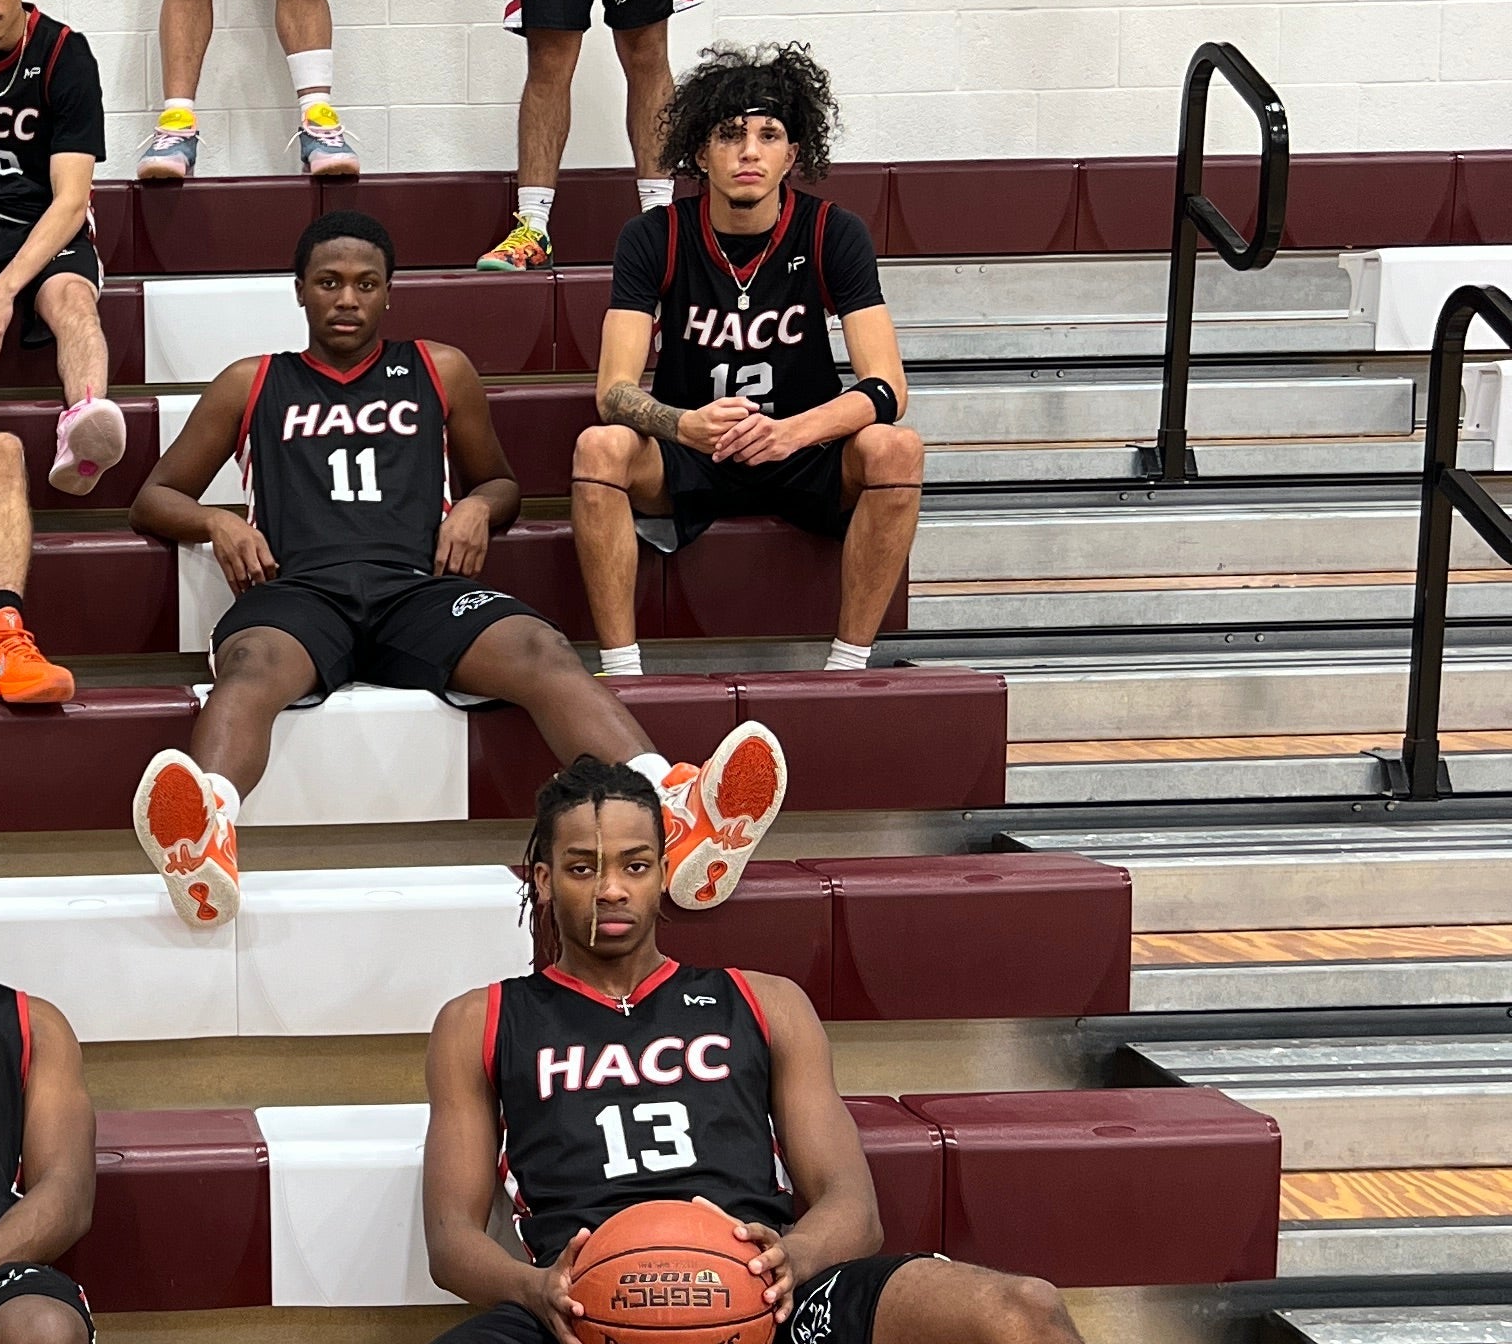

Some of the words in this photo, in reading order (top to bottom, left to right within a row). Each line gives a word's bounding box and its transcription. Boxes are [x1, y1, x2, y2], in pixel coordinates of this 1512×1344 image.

[683, 304, 806, 351] HACC
[710, 361, 775, 413] 12
[282, 400, 419, 440] HACC
[327, 447, 382, 502] 11
[683, 993, 717, 1008] MP
[537, 1033, 731, 1101] HACC
[595, 1100, 697, 1180] 13
[611, 1287, 730, 1309] LEGACY
[620, 1272, 692, 1285] 1000
